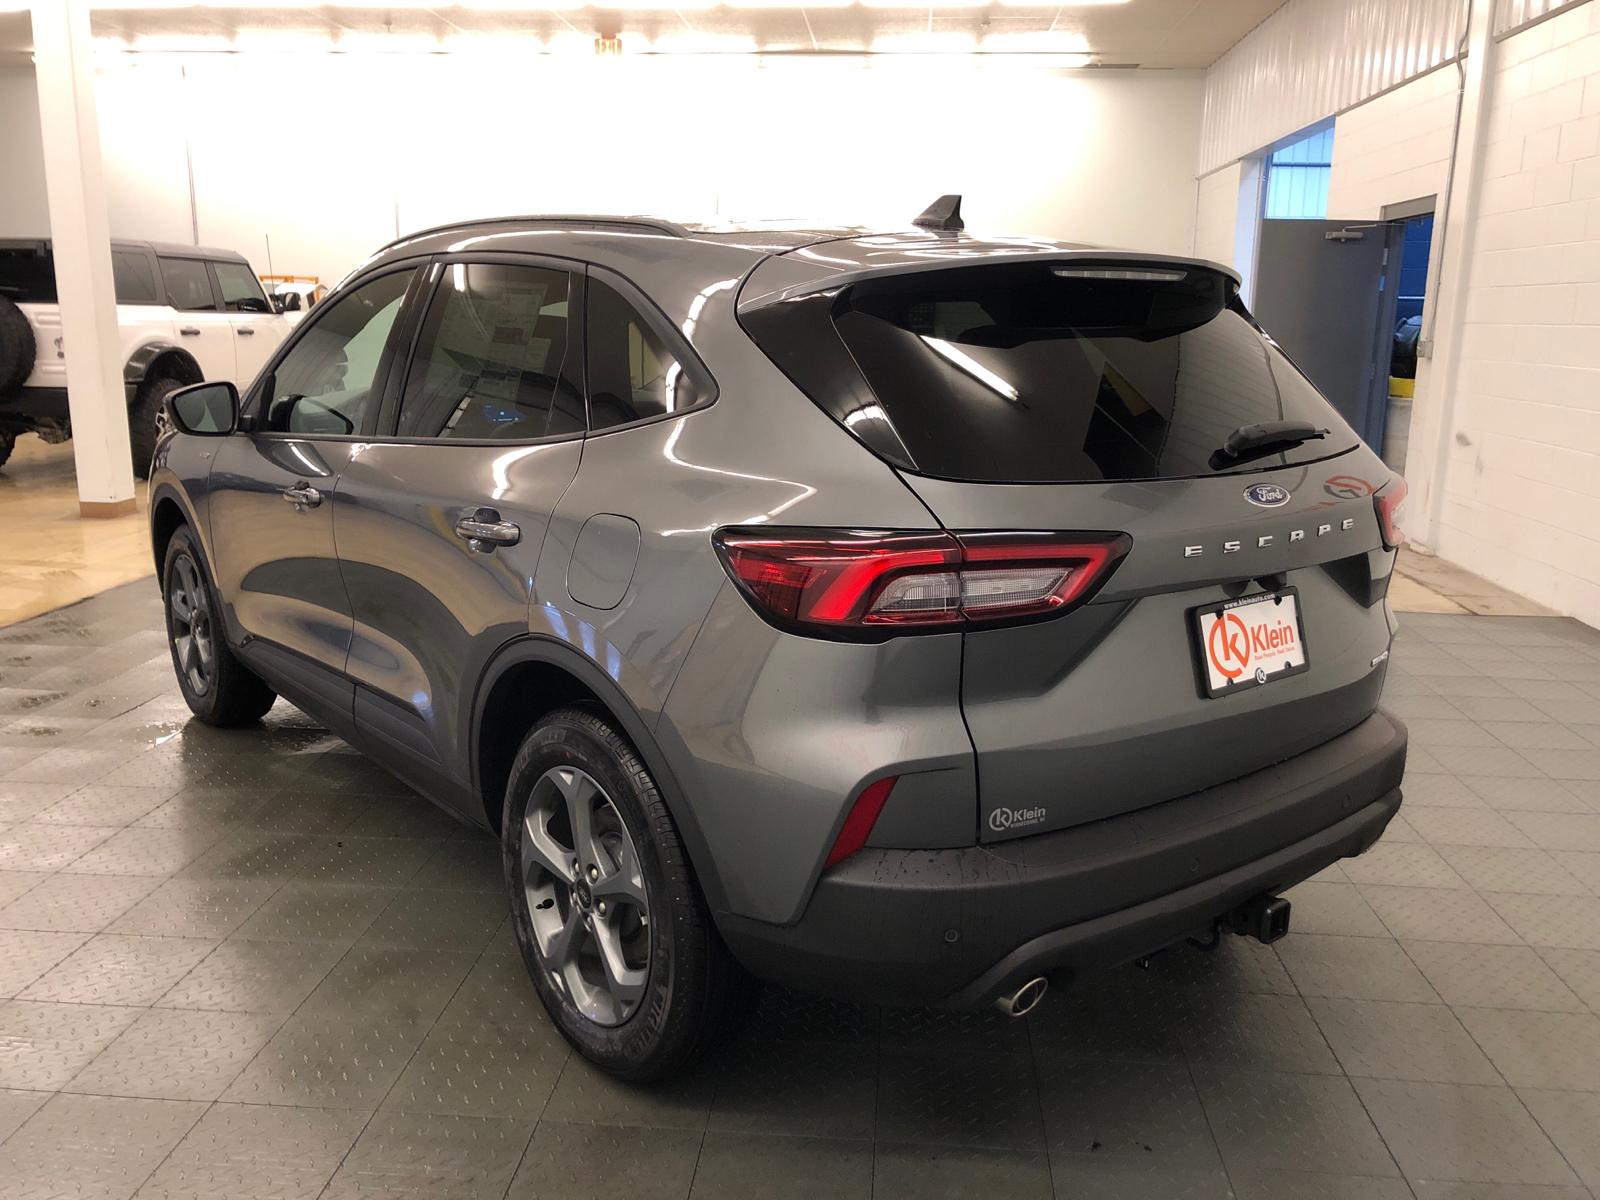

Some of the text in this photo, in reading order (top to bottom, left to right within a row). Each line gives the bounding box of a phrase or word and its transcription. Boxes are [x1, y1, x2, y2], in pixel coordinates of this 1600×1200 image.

[1256, 487, 1283, 501] Ford
[1184, 518, 1354, 558] ESCAPE
[1223, 593, 1276, 609] www.kleinauto.com
[1250, 620, 1294, 653] Klein
[1013, 806, 1046, 821] Klein
